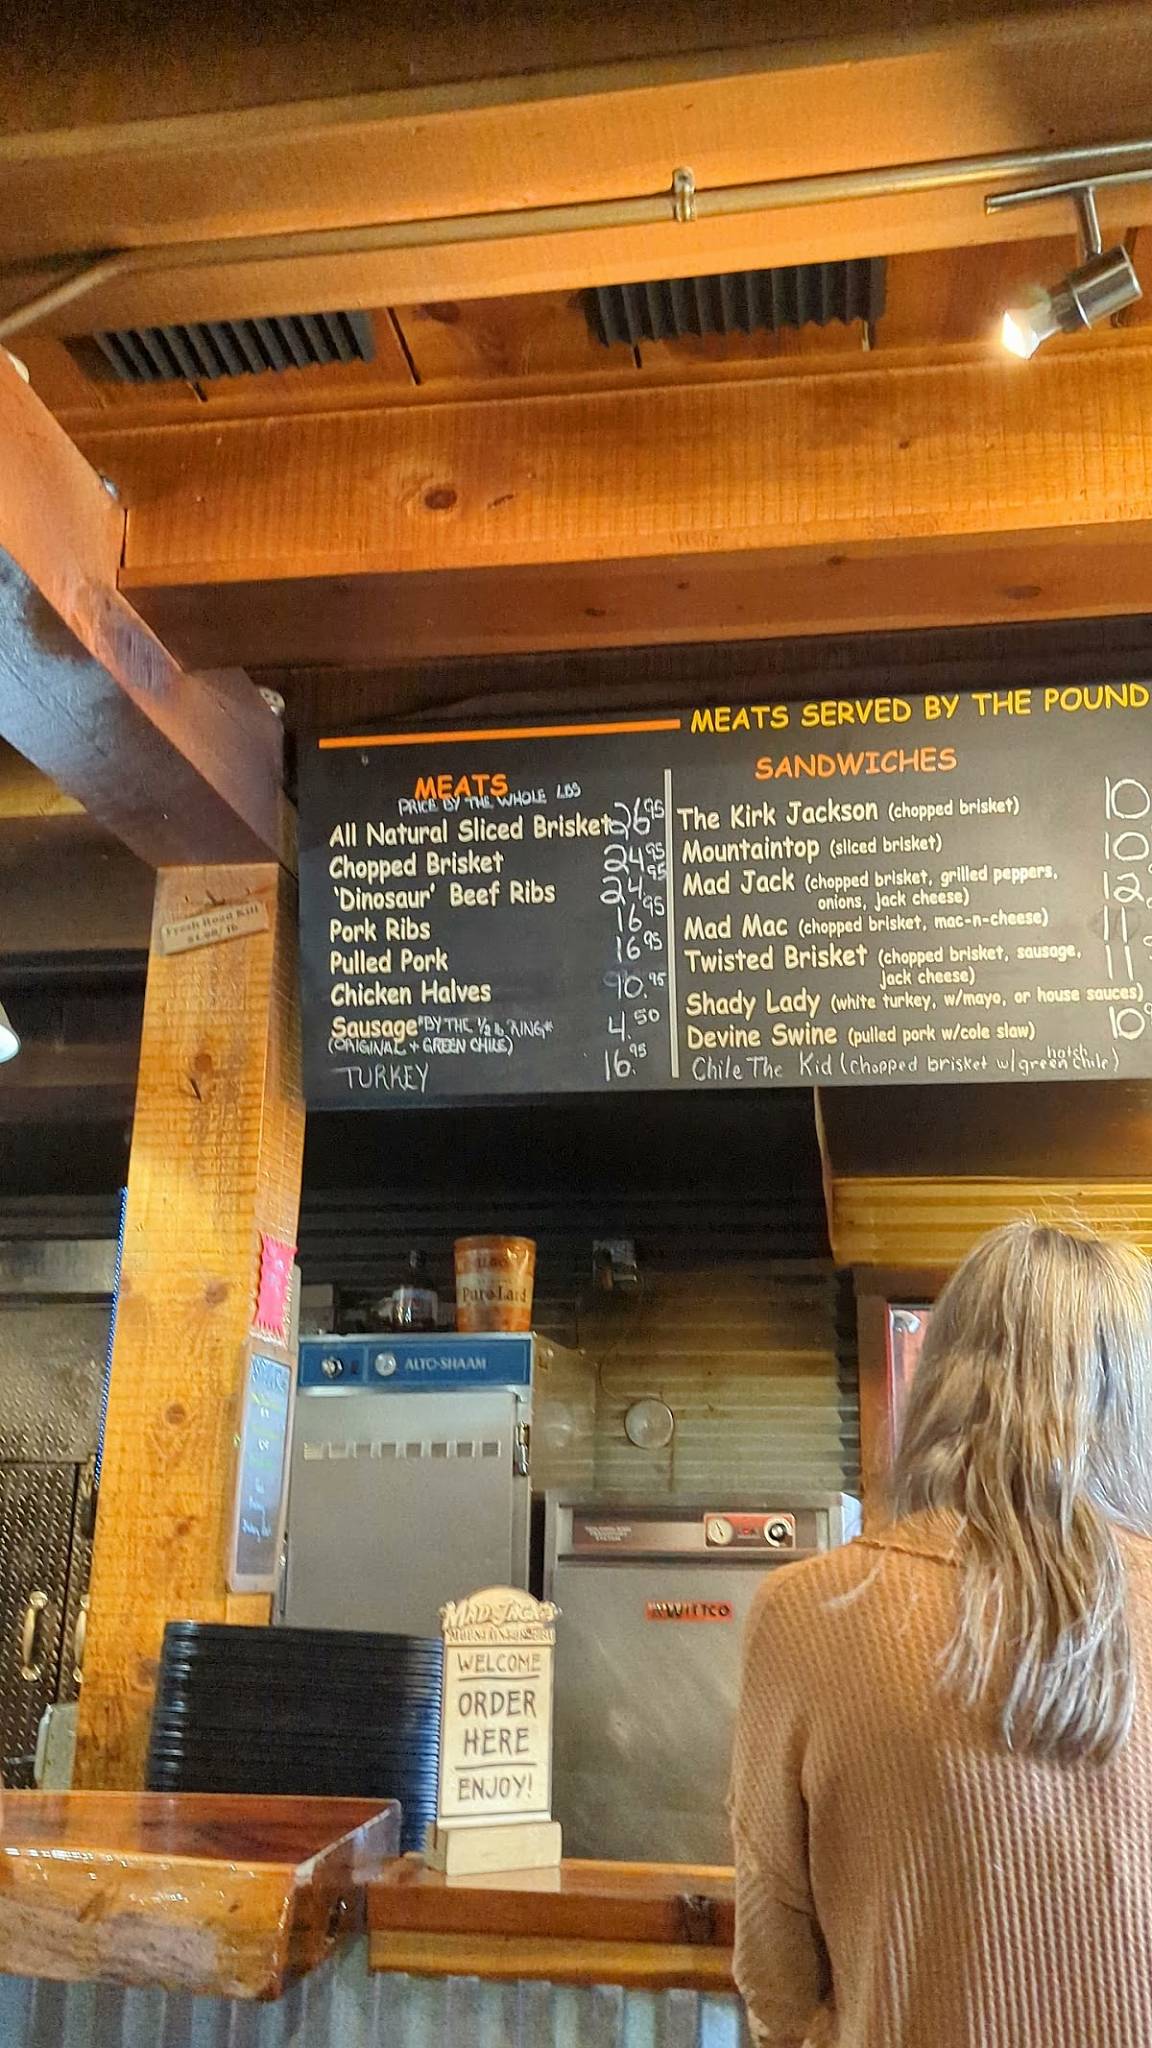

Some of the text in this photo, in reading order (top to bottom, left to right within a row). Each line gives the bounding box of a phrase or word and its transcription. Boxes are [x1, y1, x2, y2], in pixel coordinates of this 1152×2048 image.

[691, 683, 1150, 734] MEATS SERVED BY THE POUND
[756, 747, 957, 780] SANDWICHES
[414, 773, 509, 800] MEATS
[1105, 776, 1152, 820] 10
[398, 798, 438, 816] PRICE
[443, 795, 460, 812] BY
[464, 795, 494, 810] THE
[497, 788, 547, 808] WHOLE
[677, 796, 1020, 830] The Kirk Jackson (chopped brisket)
[329, 812, 611, 848] All Natural Sliced Brisket
[682, 833, 942, 864] Mountaintop (sliced brisket)
[1105, 832, 1152, 860] 10
[329, 849, 505, 886] Chopped Brisket
[683, 864, 1058, 896] Mad Jack (chopped brisket, grilled peppers,
[334, 879, 556, 912] 'Dinosaur' Beef Ribs
[818, 887, 970, 912] onions, jack cheese)
[202, 912, 234, 928] Road
[236, 904, 260, 918] Kill
[330, 917, 431, 944] Pork Ribs
[684, 907, 1048, 940] Mad Mac (chopped brisket, mac-n-cheese)
[330, 947, 449, 976] Pulled Pork
[684, 942, 1082, 974] Twisted Brisket (chopped brisket, sausage,
[330, 978, 492, 1008] Chicken Halves
[880, 966, 976, 990] jack cheese)
[686, 982, 1144, 1021] Shady Lady (white turkey, w/mayo, or house sauces)
[331, 1016, 418, 1043] Sausage
[445, 1016, 473, 1034] THE
[687, 1020, 1036, 1050] Devine Swine (pulled pork w/cole slaw)
[328, 1037, 407, 1056] (ORIGINAL
[423, 1037, 466, 1055] GREEN
[330, 1062, 429, 1093] TURKEY
[692, 1055, 744, 1081] Chile
[746, 1055, 783, 1079] The
[800, 1050, 832, 1077] Kid
[840, 1046, 918, 1076] (chopped
[927, 1055, 988, 1072] brisket
[458, 1652, 541, 1674] WELCOME
[458, 1690, 537, 1718] ORDER
[464, 1728, 529, 1756] HERE
[458, 1774, 533, 1801] ENJOY!
